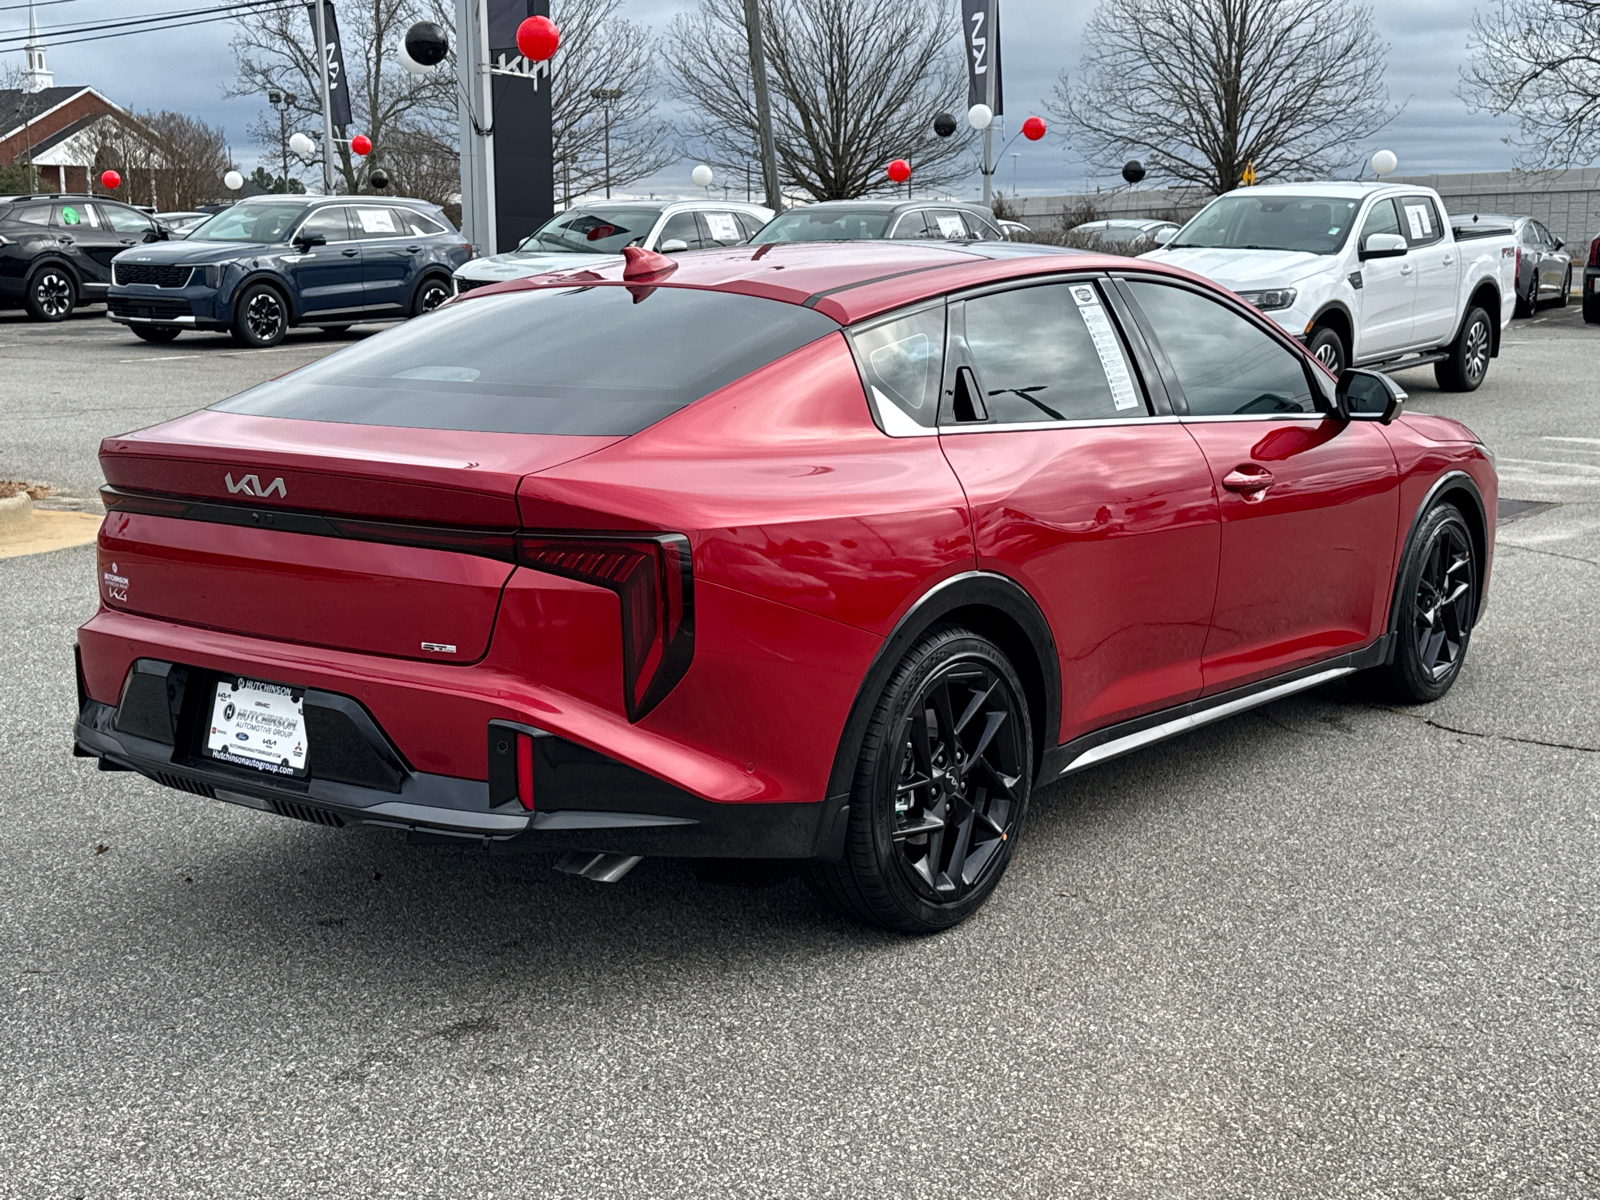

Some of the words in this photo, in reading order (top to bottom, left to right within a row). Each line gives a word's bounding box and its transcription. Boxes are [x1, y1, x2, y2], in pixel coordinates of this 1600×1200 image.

[497, 52, 549, 78] KIA
[224, 471, 288, 499] KIA
[109, 586, 127, 602] K4
[246, 680, 291, 696] HUTCHINSON
[235, 721, 272, 734] AUTOMOTIVE
[272, 729, 293, 738] GROUP
[236, 709, 298, 731] HUTCHINSON
[212, 750, 294, 775] Hutchinsonautogroup.com
